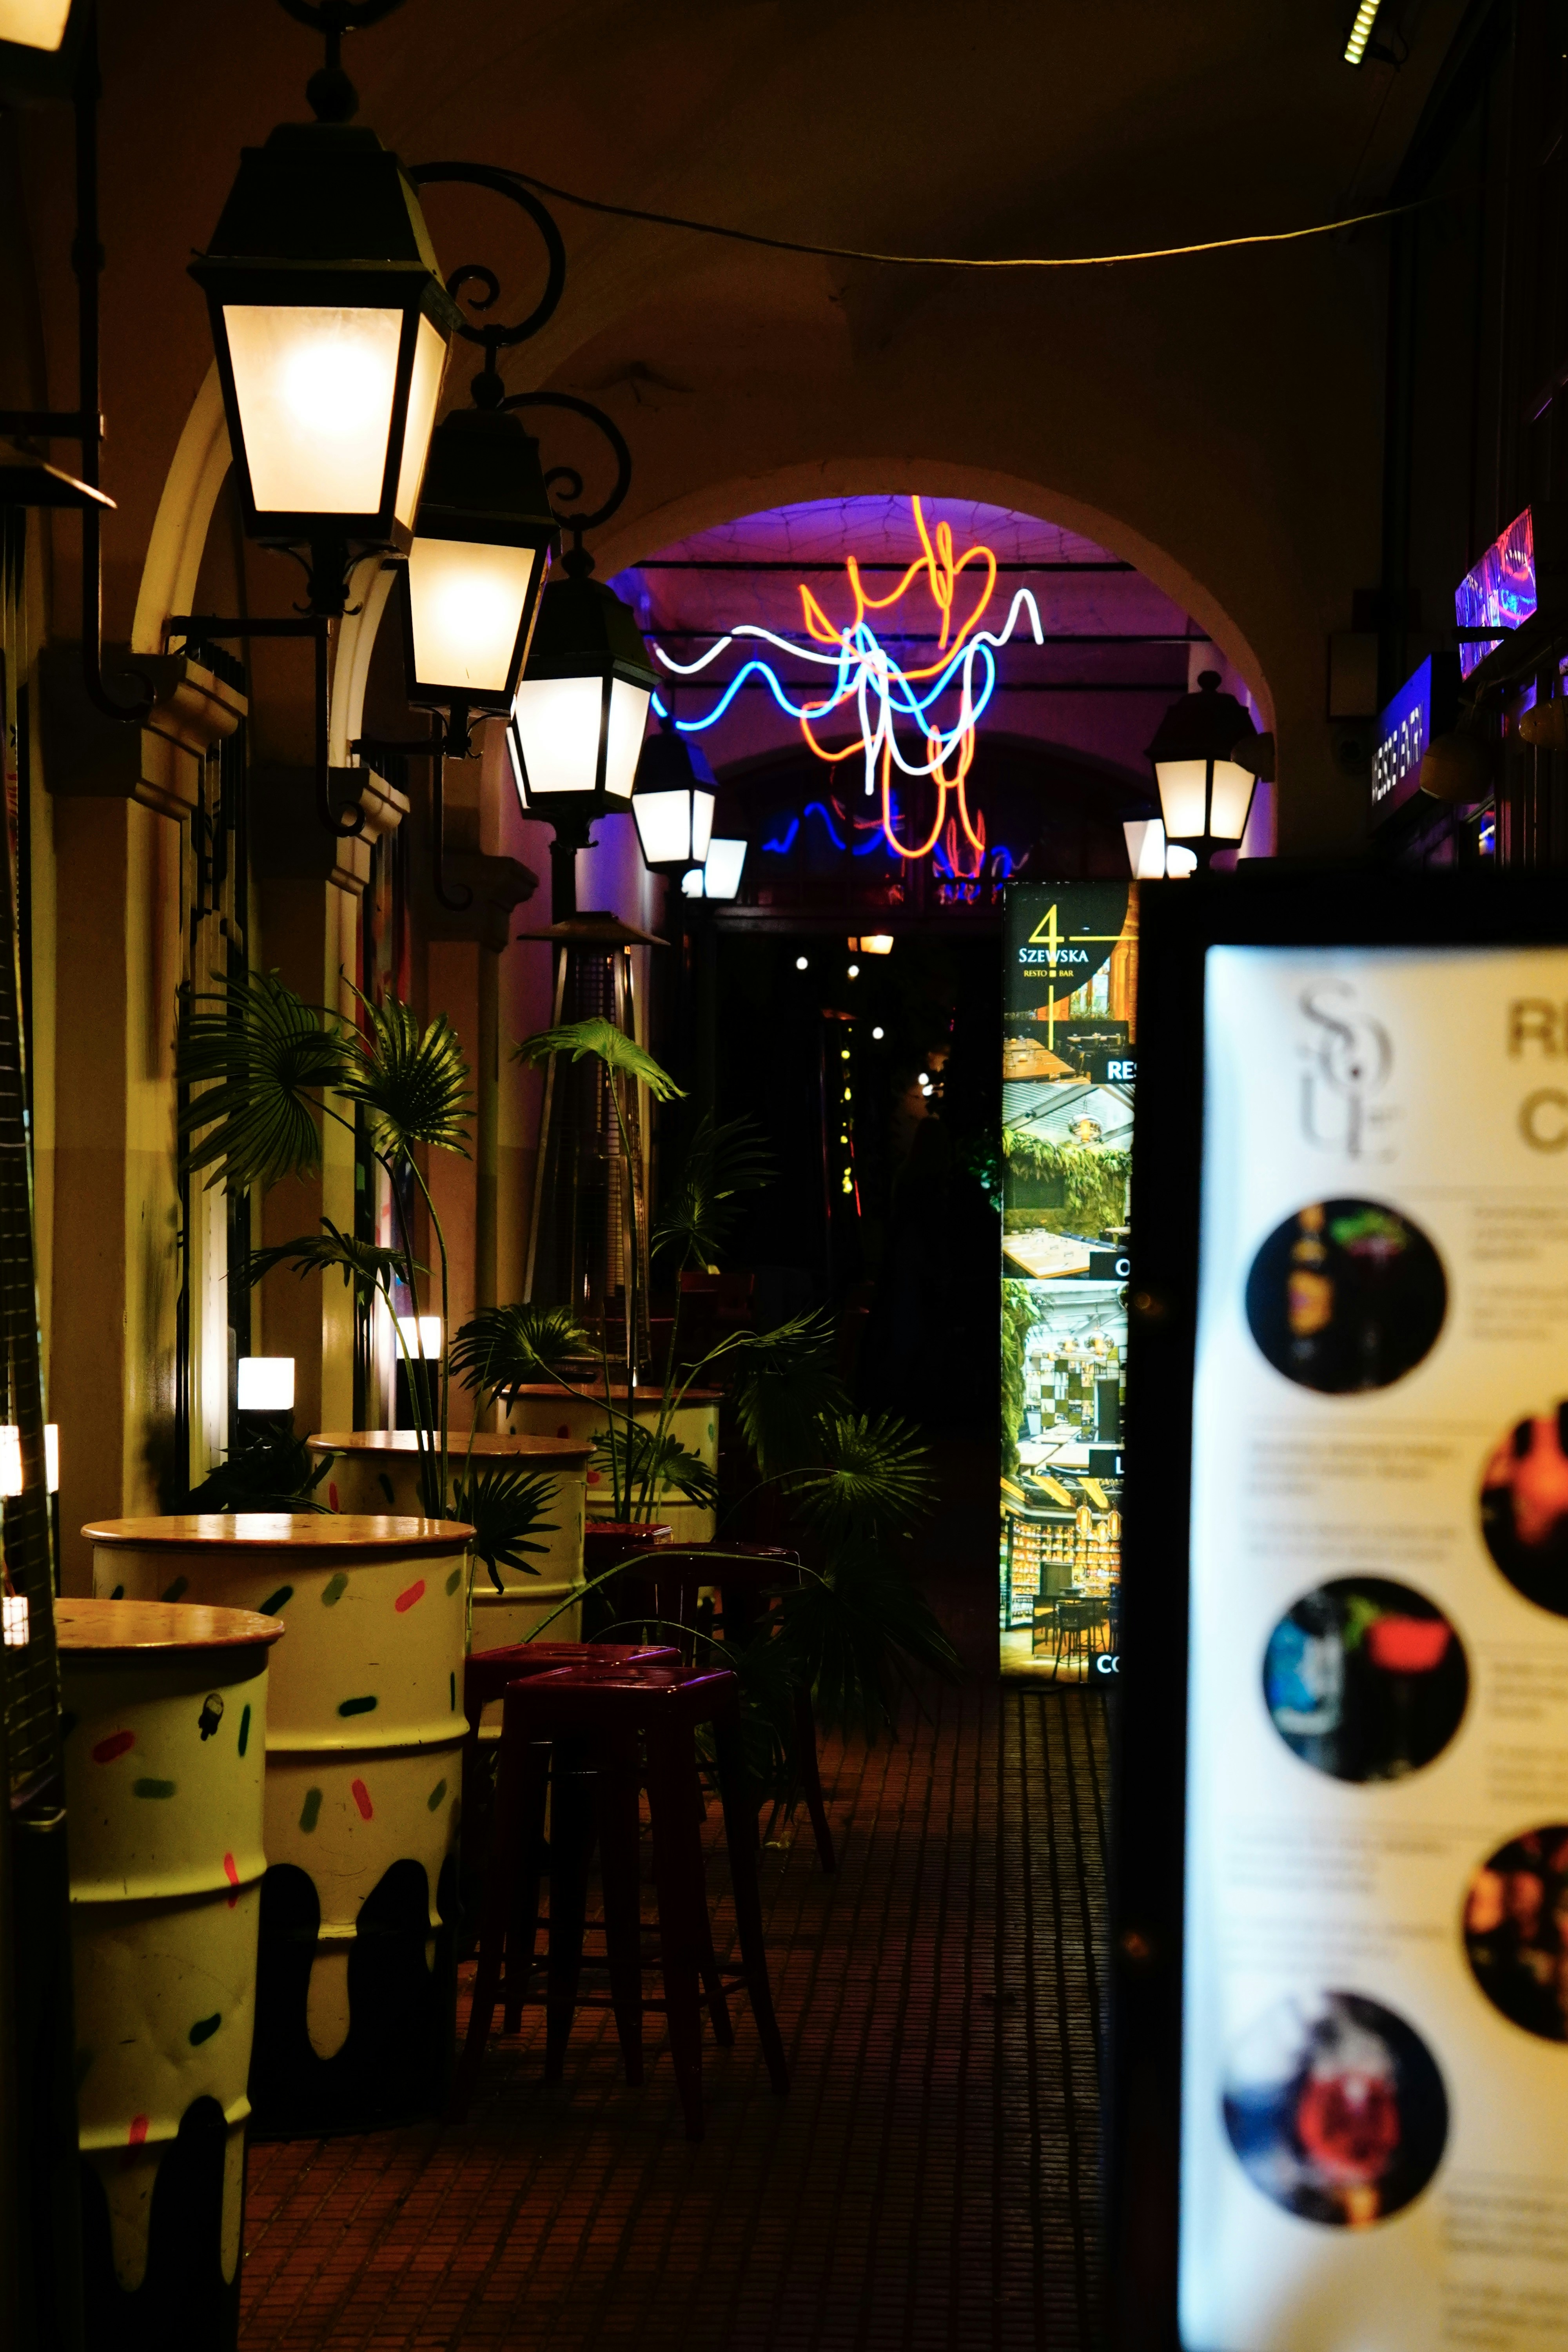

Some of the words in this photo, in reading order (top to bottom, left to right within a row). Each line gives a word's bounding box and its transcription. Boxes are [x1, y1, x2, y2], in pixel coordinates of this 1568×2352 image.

[1029, 904, 1065, 967] 4
[1019, 948, 1089, 963] SZEWSKA
[1024, 969, 1048, 978] RESTO
[1059, 969, 1074, 978] BAR
[1108, 1061, 1137, 1080] RE
